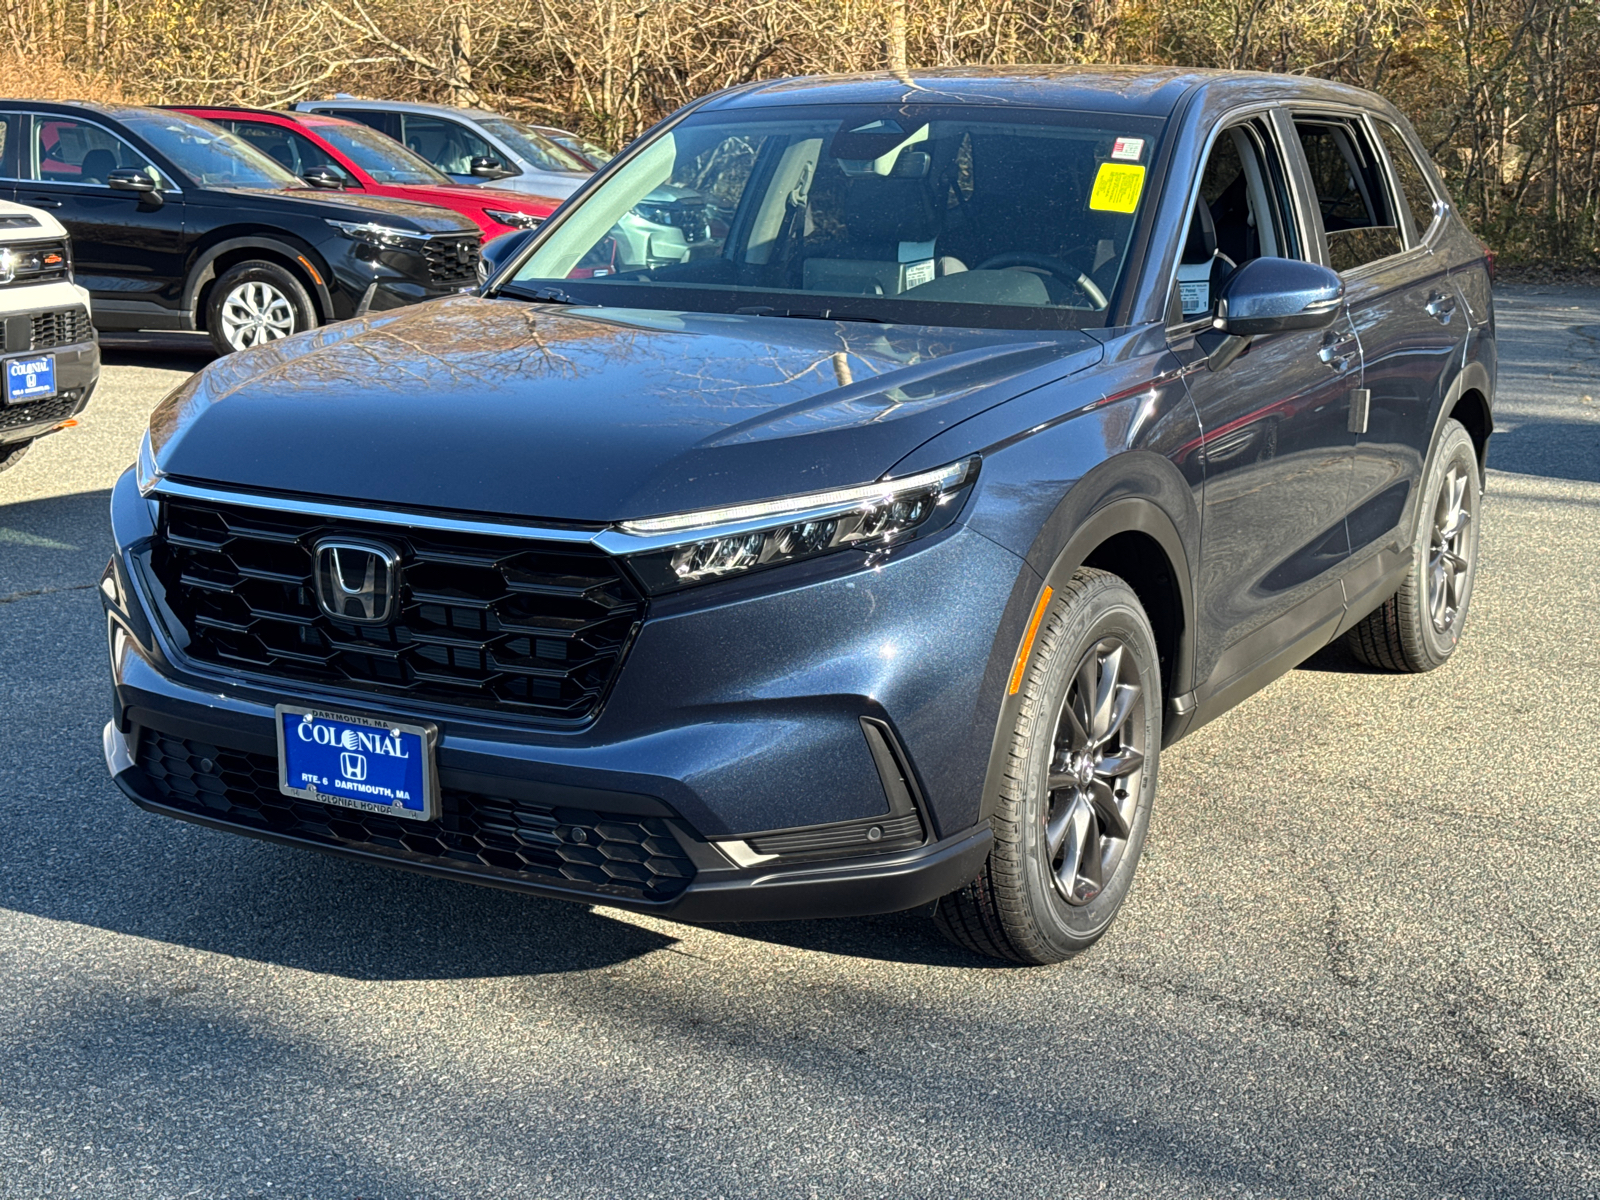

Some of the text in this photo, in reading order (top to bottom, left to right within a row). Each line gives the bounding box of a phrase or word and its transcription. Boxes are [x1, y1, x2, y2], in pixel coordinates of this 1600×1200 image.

[11, 361, 49, 376] COLONIAL
[374, 720, 389, 728] MA
[297, 722, 409, 759] COLONIAL
[301, 773, 410, 800] RTE. 6 DARTMOUTH, MA
[315, 793, 392, 815] COLONIAL HONDA
